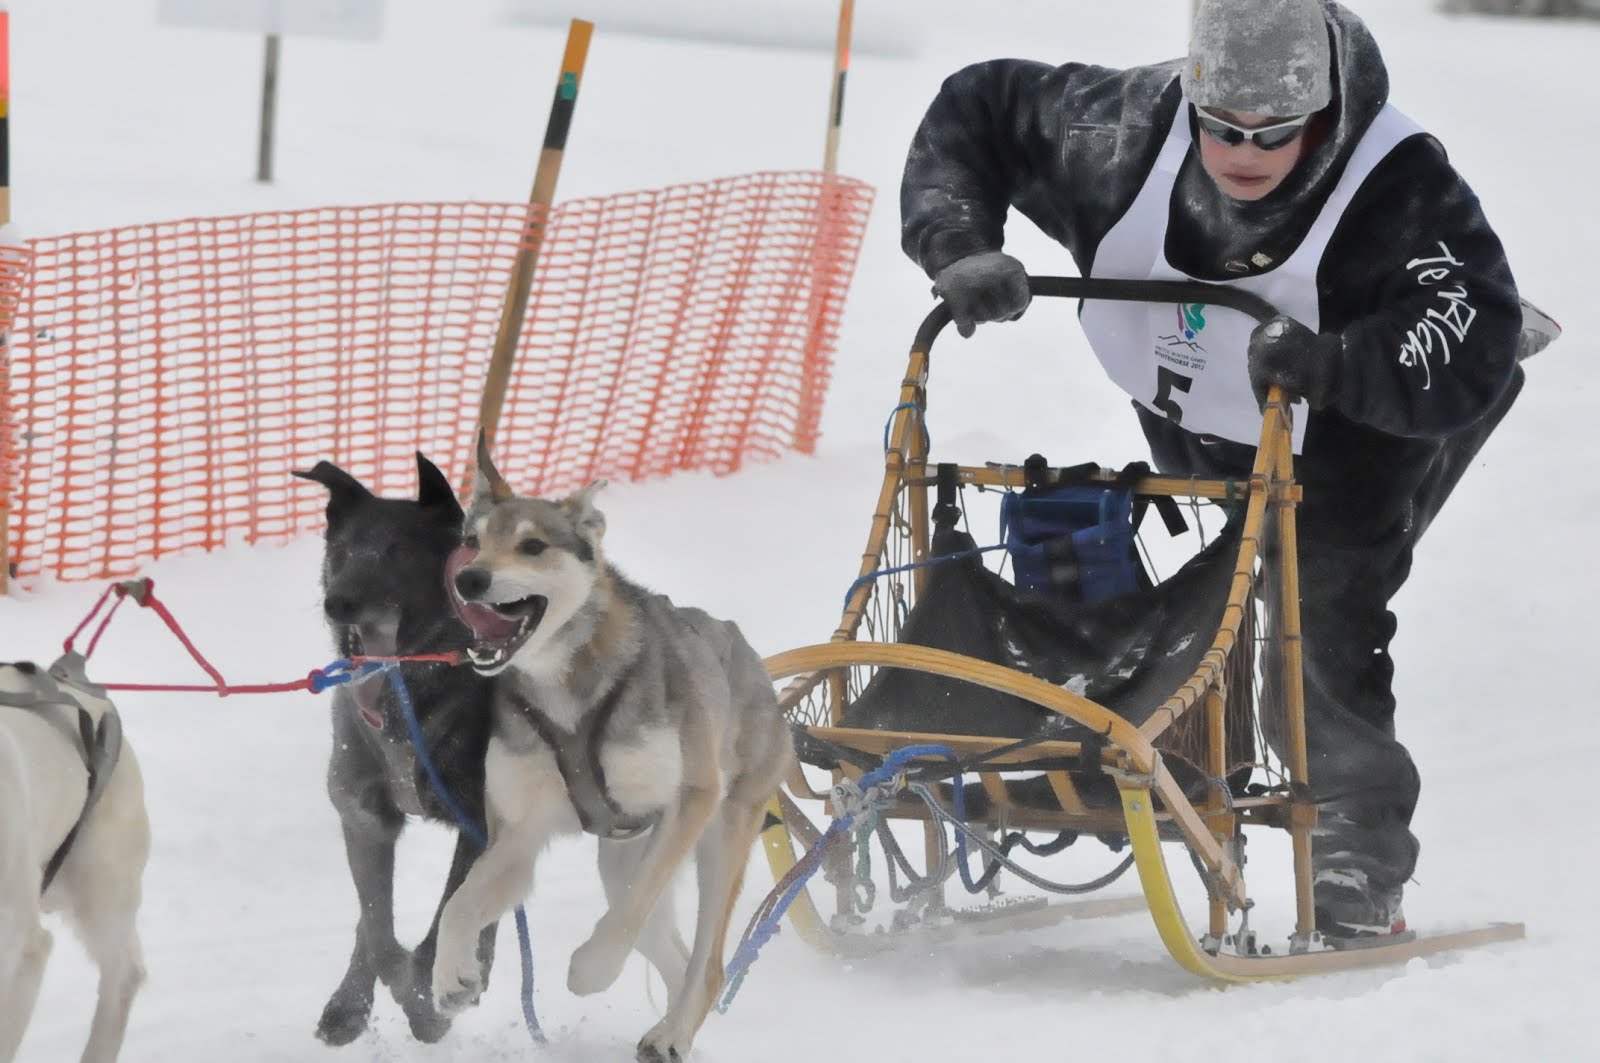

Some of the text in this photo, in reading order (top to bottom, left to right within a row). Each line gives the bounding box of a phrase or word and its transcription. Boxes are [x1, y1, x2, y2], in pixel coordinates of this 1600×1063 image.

[1154, 350, 1205, 371] WHITEHORSE 2012
[1152, 365, 1193, 425] 5
